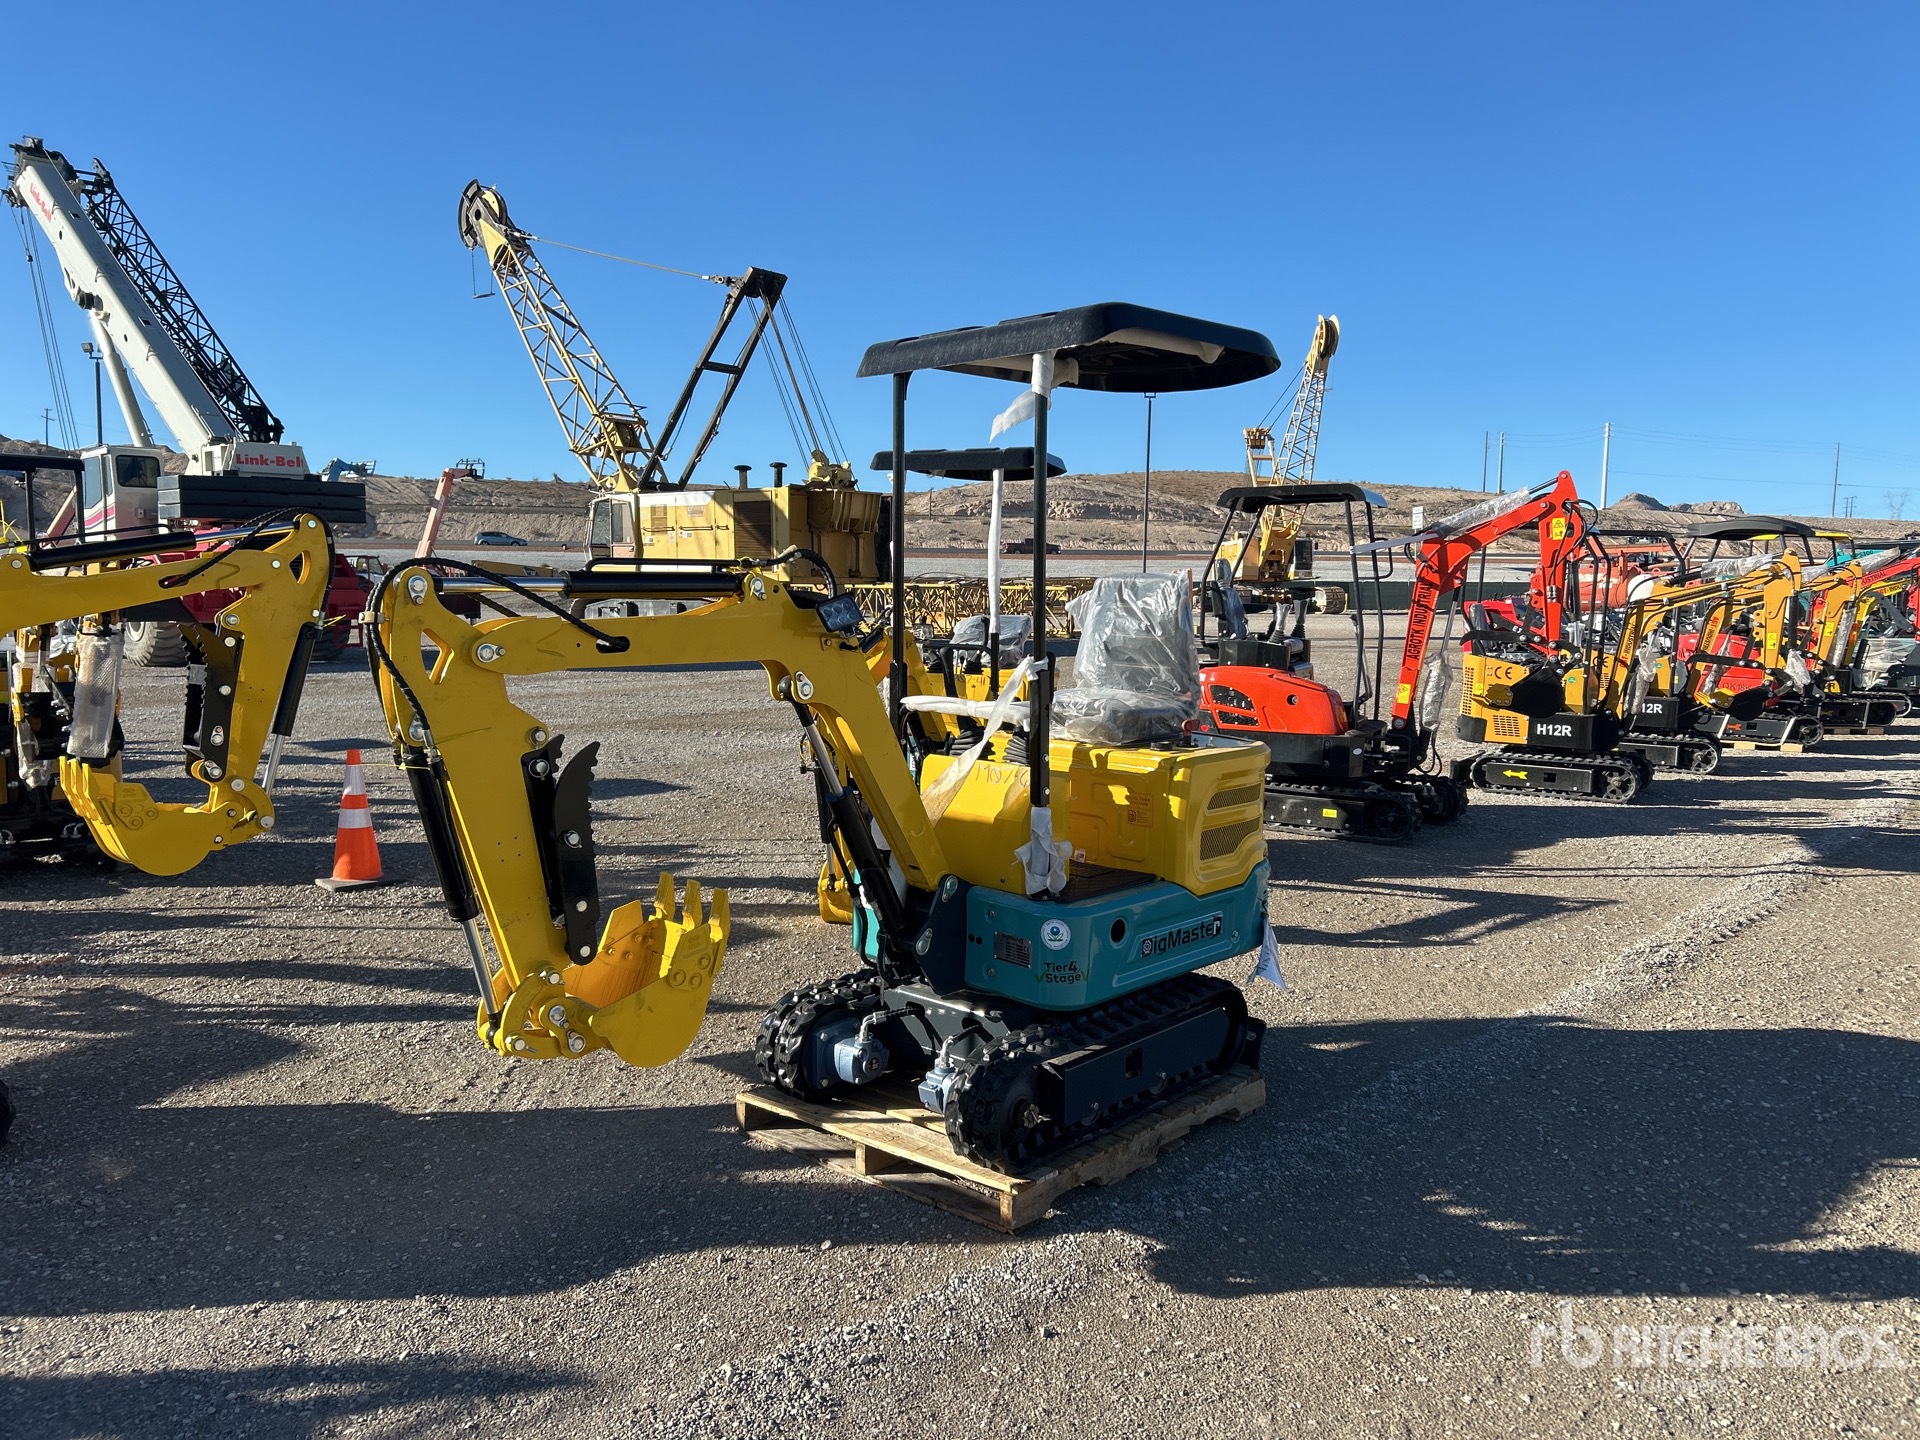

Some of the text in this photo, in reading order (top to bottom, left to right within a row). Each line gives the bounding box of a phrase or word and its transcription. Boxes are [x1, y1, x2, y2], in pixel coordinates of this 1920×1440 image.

[1407, 583, 1434, 660] AGROTK INDUSTRIAL
[1641, 703, 1663, 714] 12R
[1536, 723, 1572, 737] H12R
[1141, 916, 1222, 957] DigMaster
[1045, 973, 1082, 985] Stage
